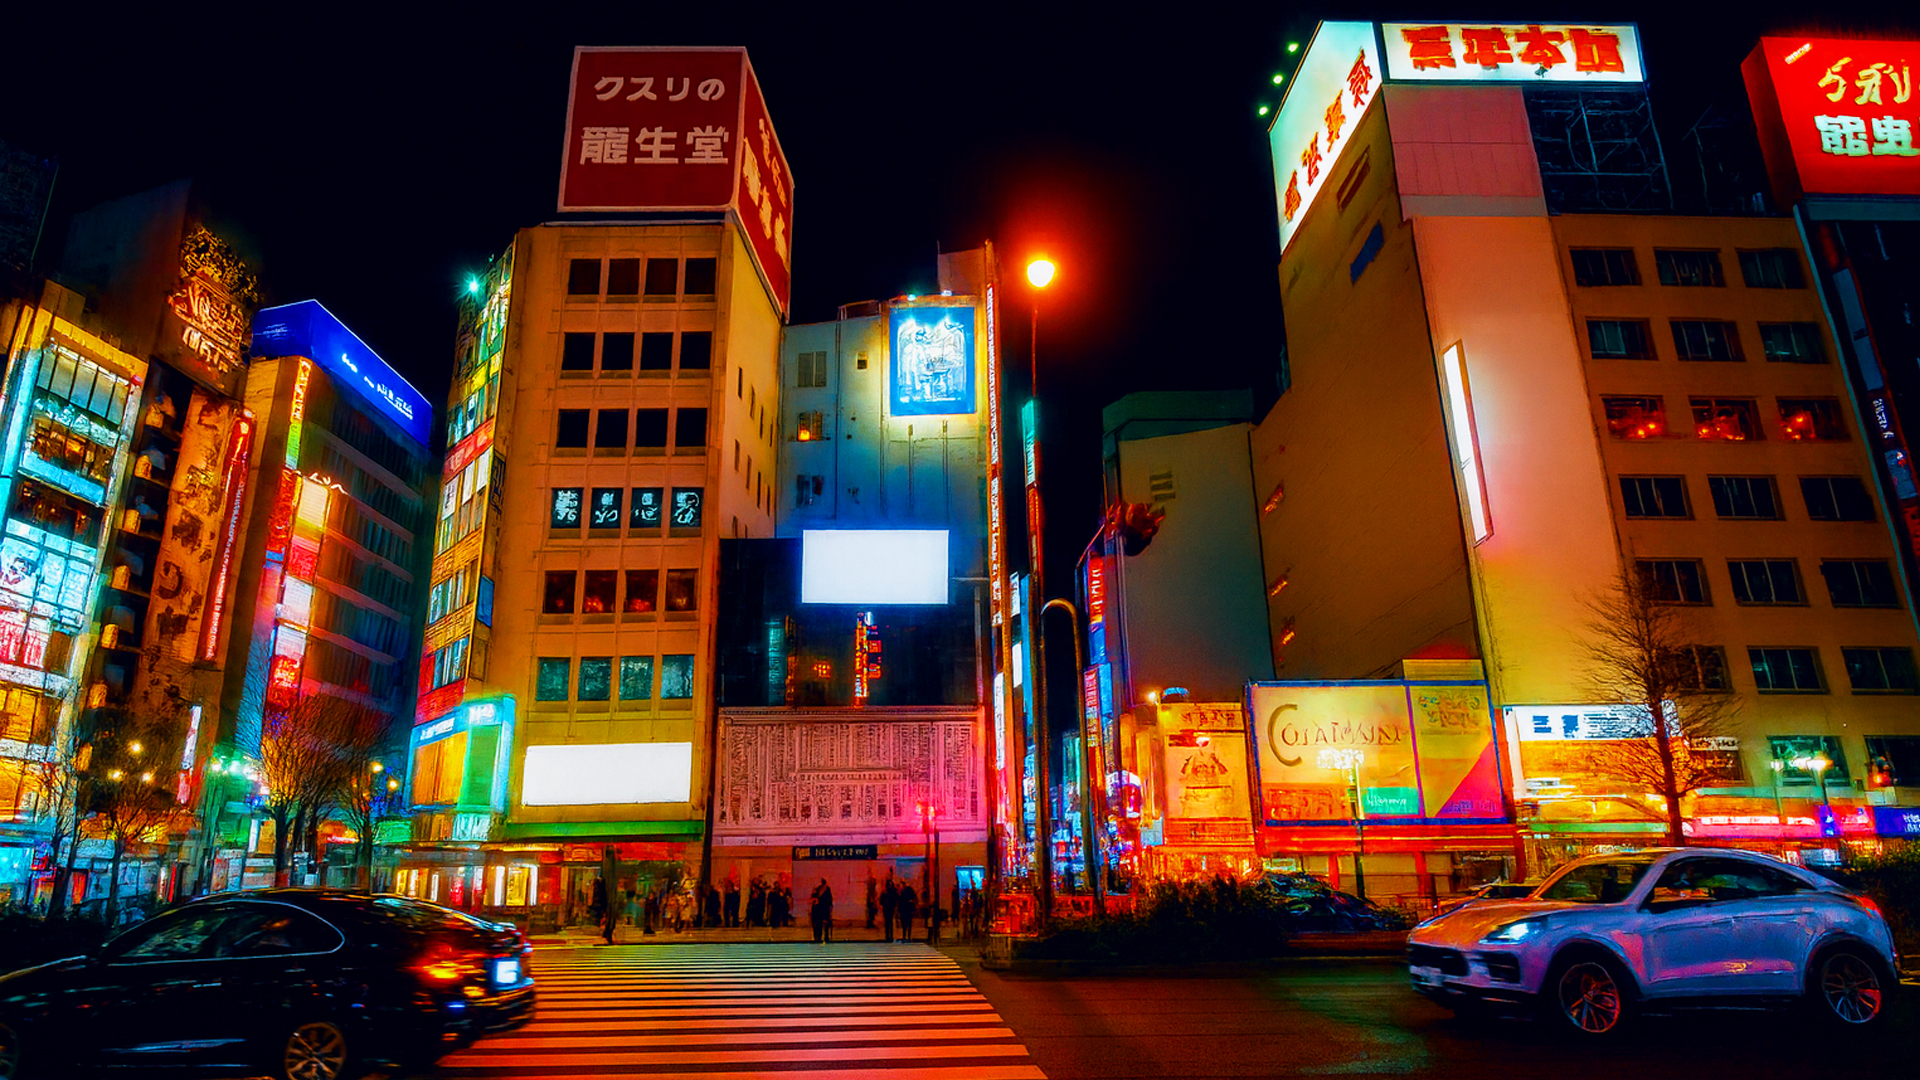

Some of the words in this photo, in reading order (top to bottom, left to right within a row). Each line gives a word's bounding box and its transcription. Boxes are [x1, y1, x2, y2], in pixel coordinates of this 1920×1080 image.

[594, 76, 726, 102] クスリの
[579, 125, 729, 165] 龍生堂
